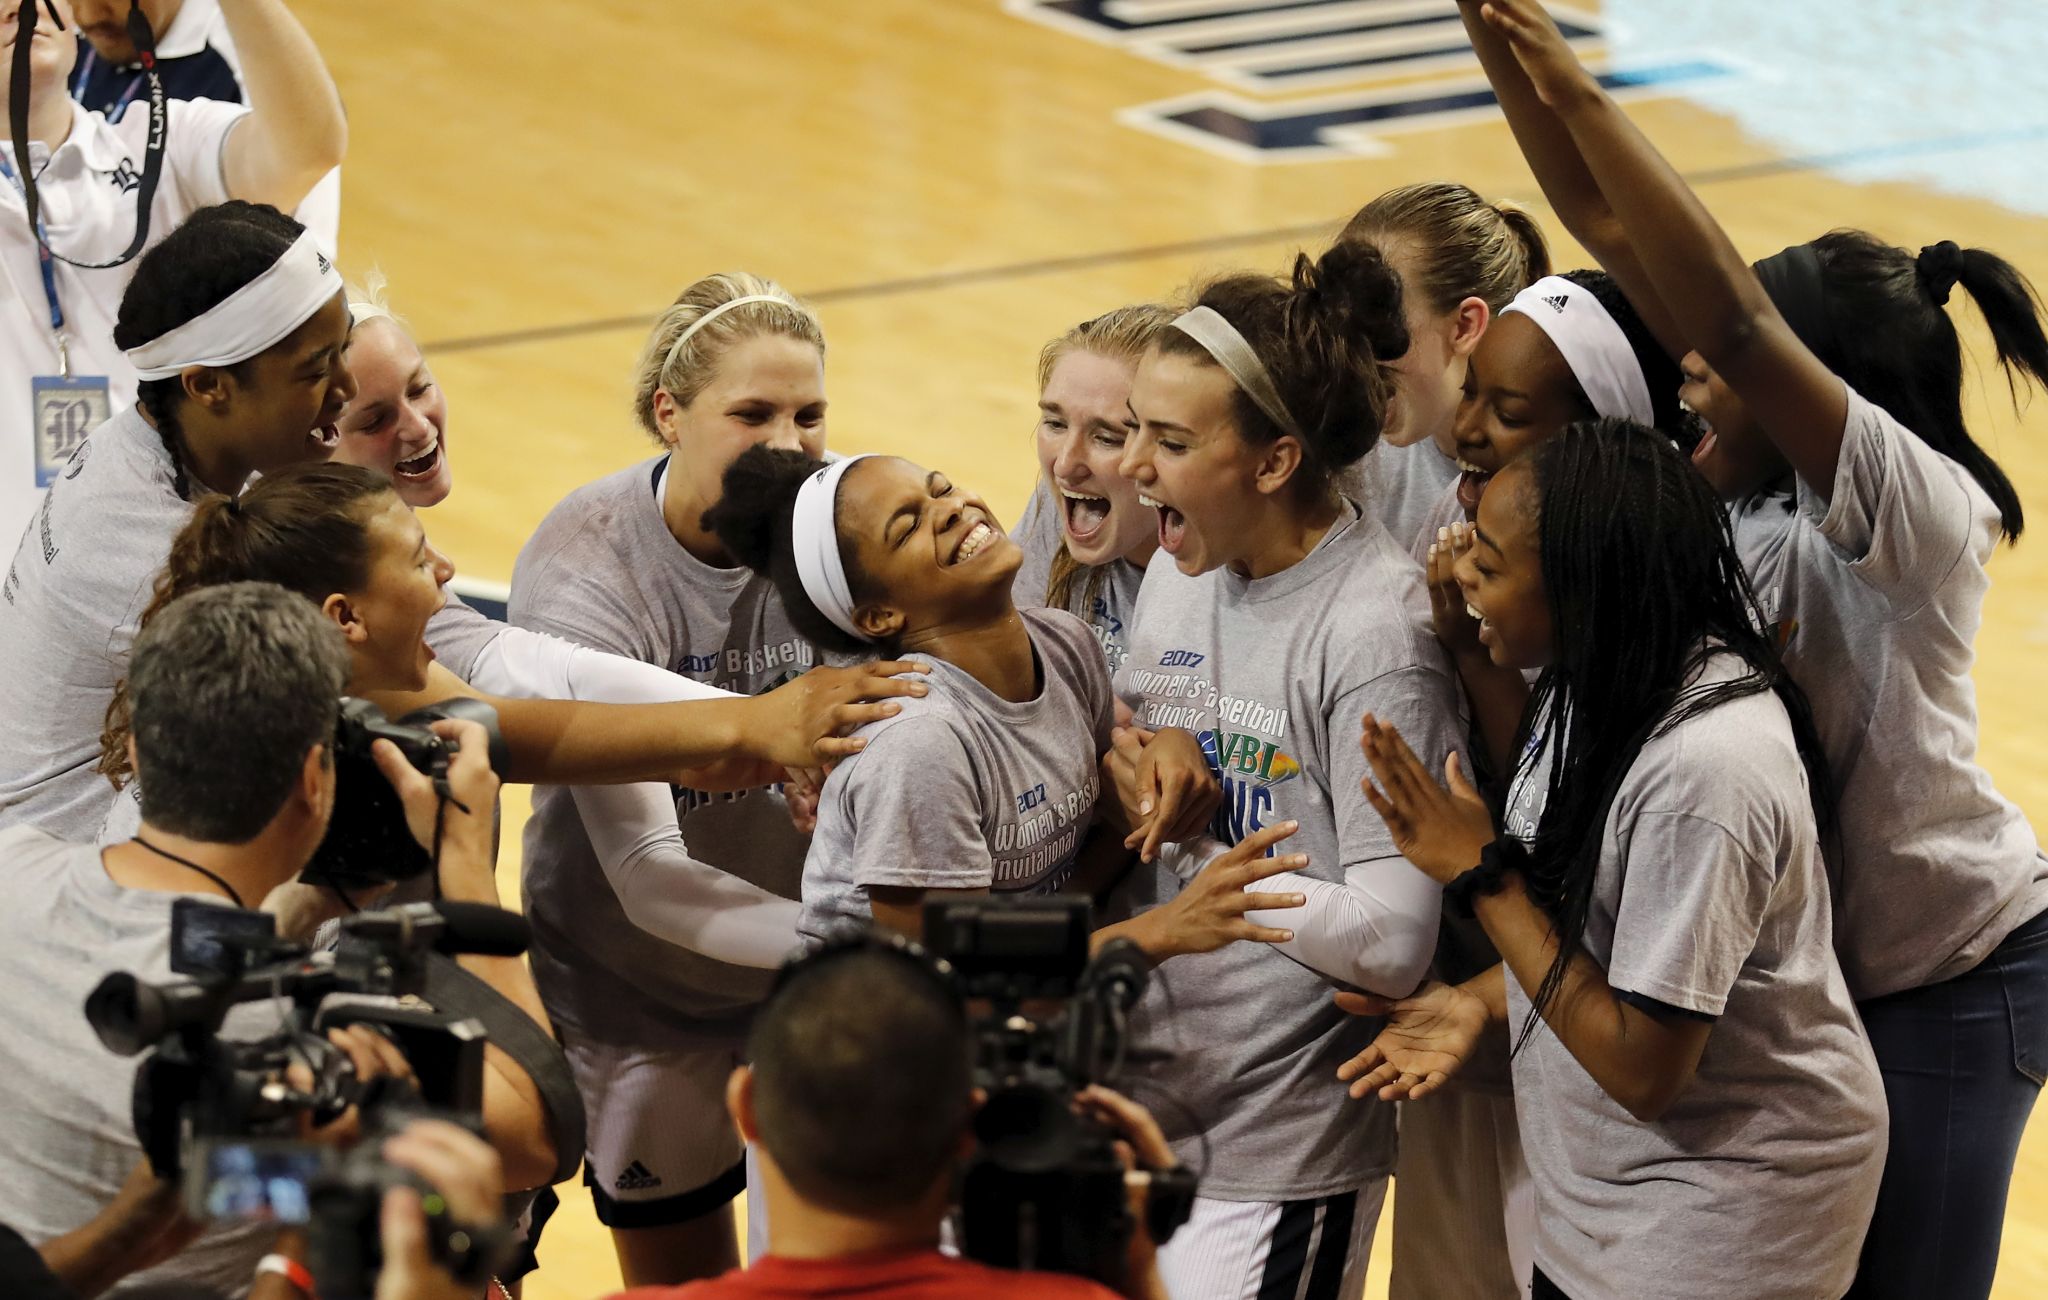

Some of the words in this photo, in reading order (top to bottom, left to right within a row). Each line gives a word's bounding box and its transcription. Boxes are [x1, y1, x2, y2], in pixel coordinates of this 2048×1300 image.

[148, 71, 164, 149] LUMIX
[1159, 650, 1205, 669] 2017
[994, 804, 1068, 852] Women's
